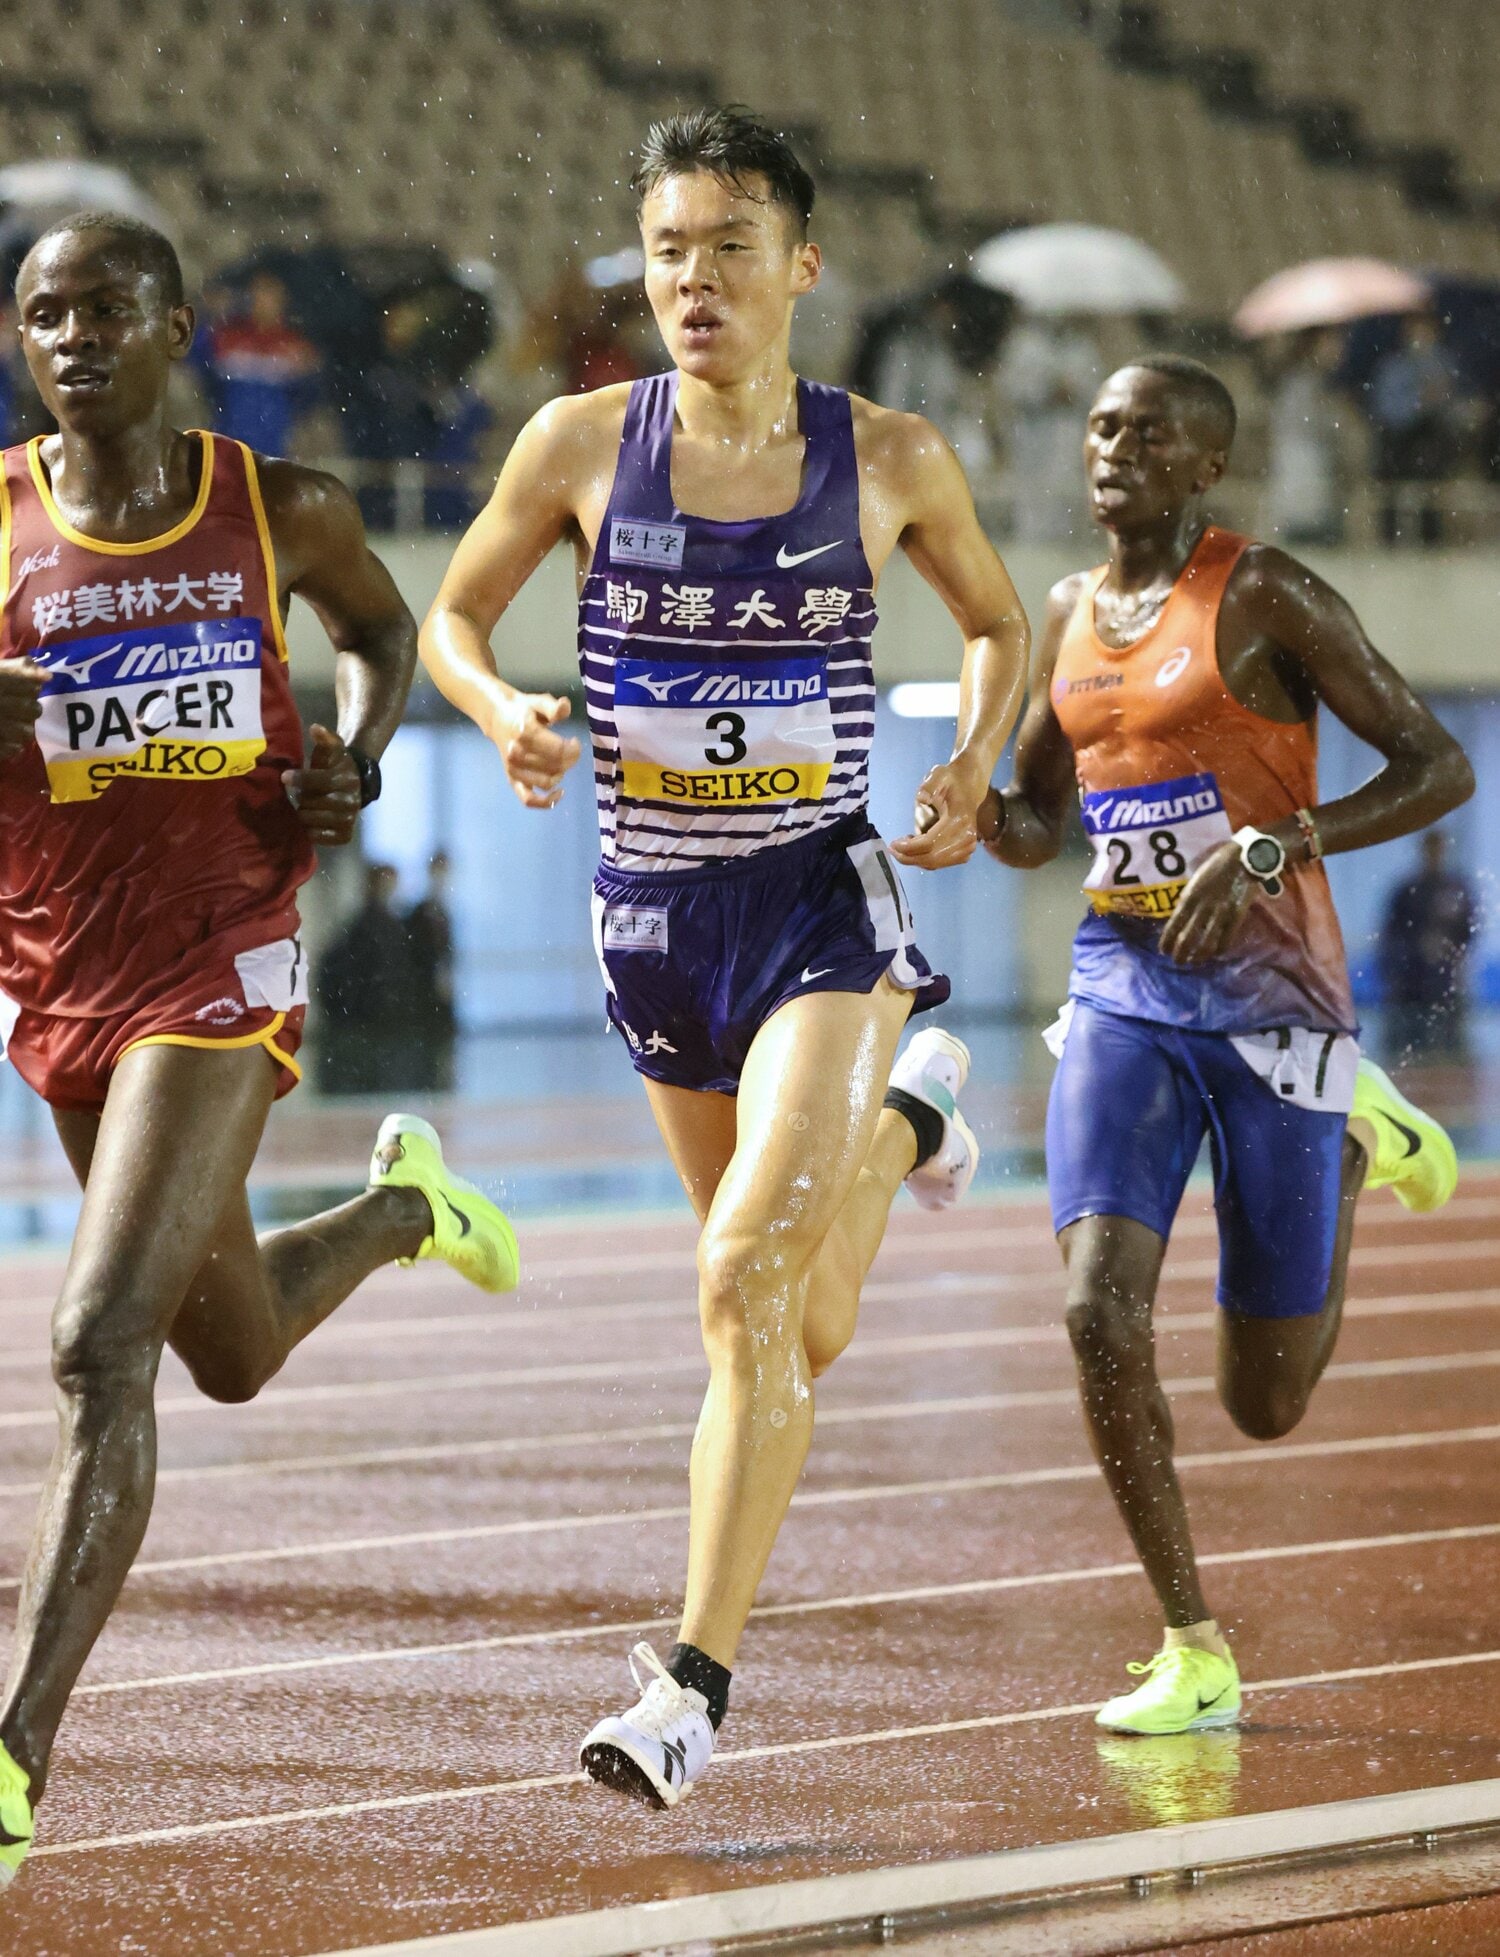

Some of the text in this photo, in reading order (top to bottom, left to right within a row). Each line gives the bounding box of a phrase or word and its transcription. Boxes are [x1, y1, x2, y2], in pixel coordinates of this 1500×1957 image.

[616, 528, 678, 553] 桜十字
[31, 571, 244, 635] 桜美林大学
[66, 680, 234, 751] PACER
[704, 711, 747, 766] 3
[660, 768, 800, 801] SEIKO
[1107, 829, 1187, 886] 28
[610, 914, 662, 936] 桜十字
